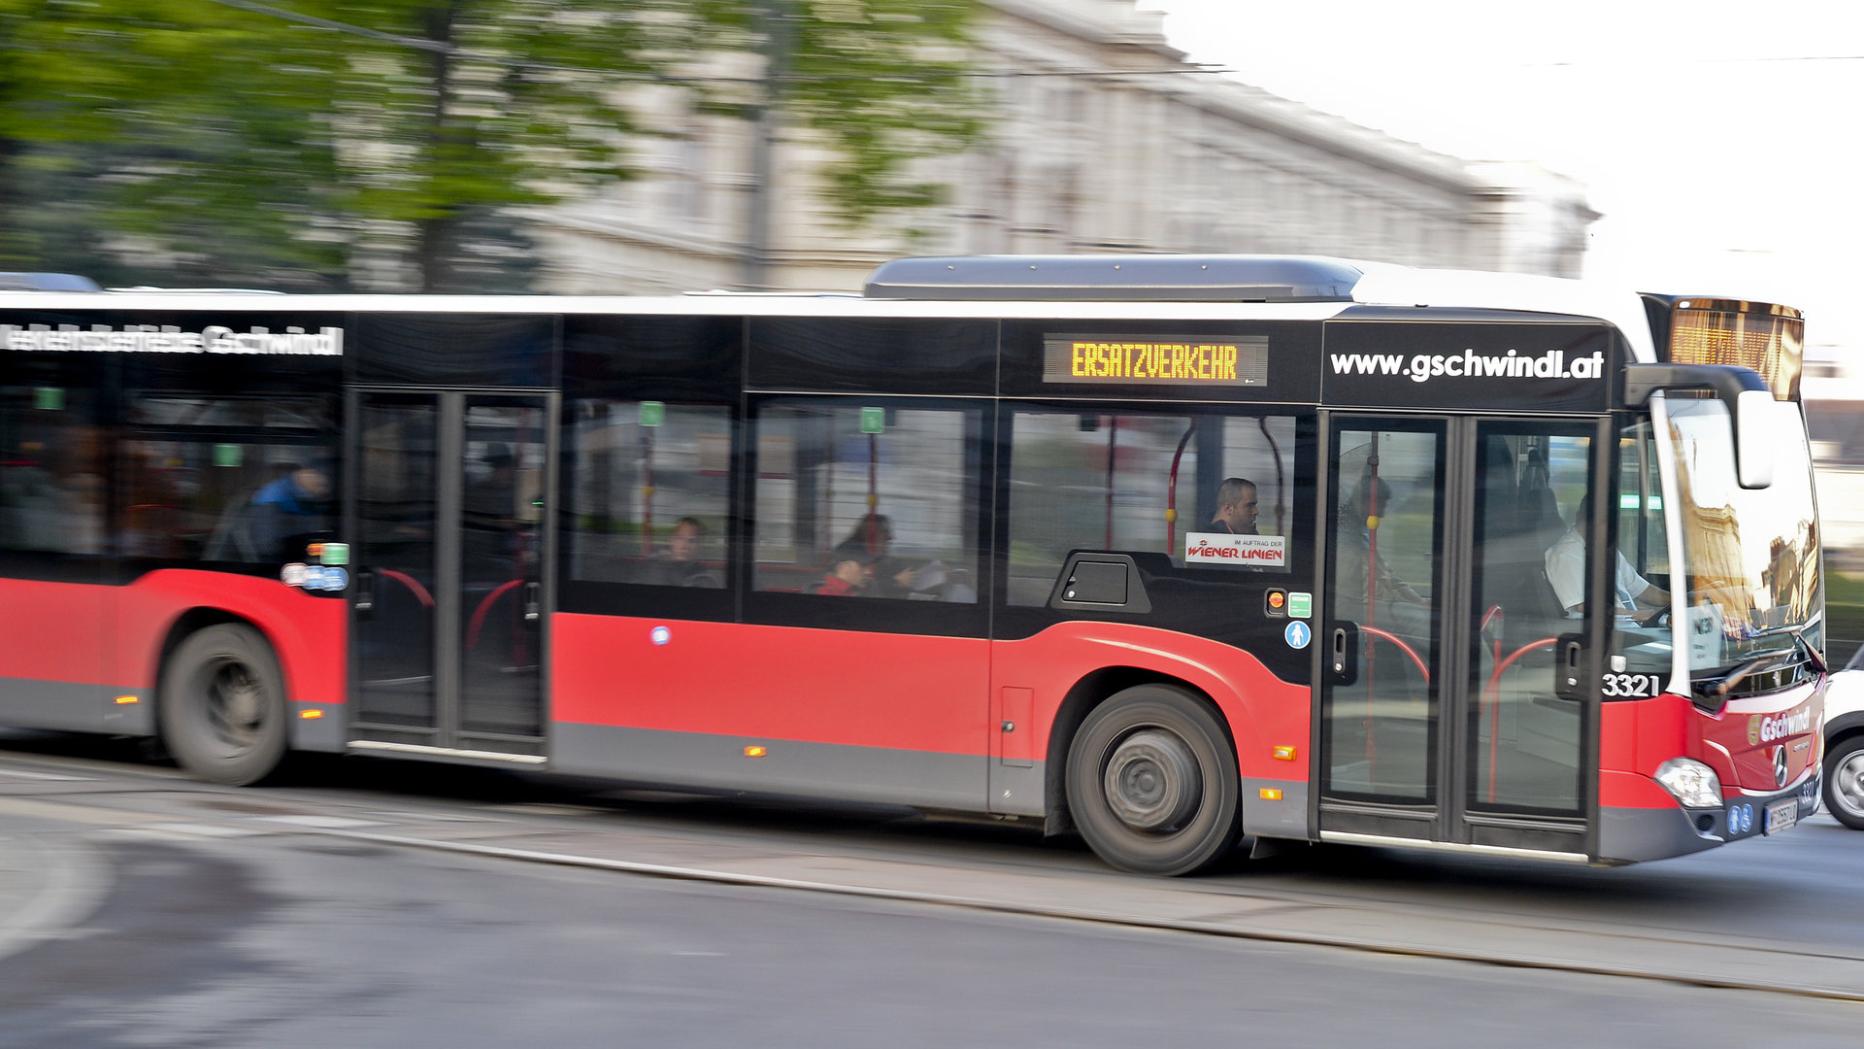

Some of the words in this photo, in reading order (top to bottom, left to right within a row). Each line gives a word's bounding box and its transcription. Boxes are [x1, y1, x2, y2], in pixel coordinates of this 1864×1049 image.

[1071, 342, 1238, 380] ERSATZVERKEHR
[1330, 348, 1605, 383] www.gschwindl.at
[1188, 547, 1239, 558] WIENER
[1241, 549, 1282, 560] LINIEN
[1601, 673, 1660, 698] 3321
[1760, 705, 1811, 743] Gschwindl
